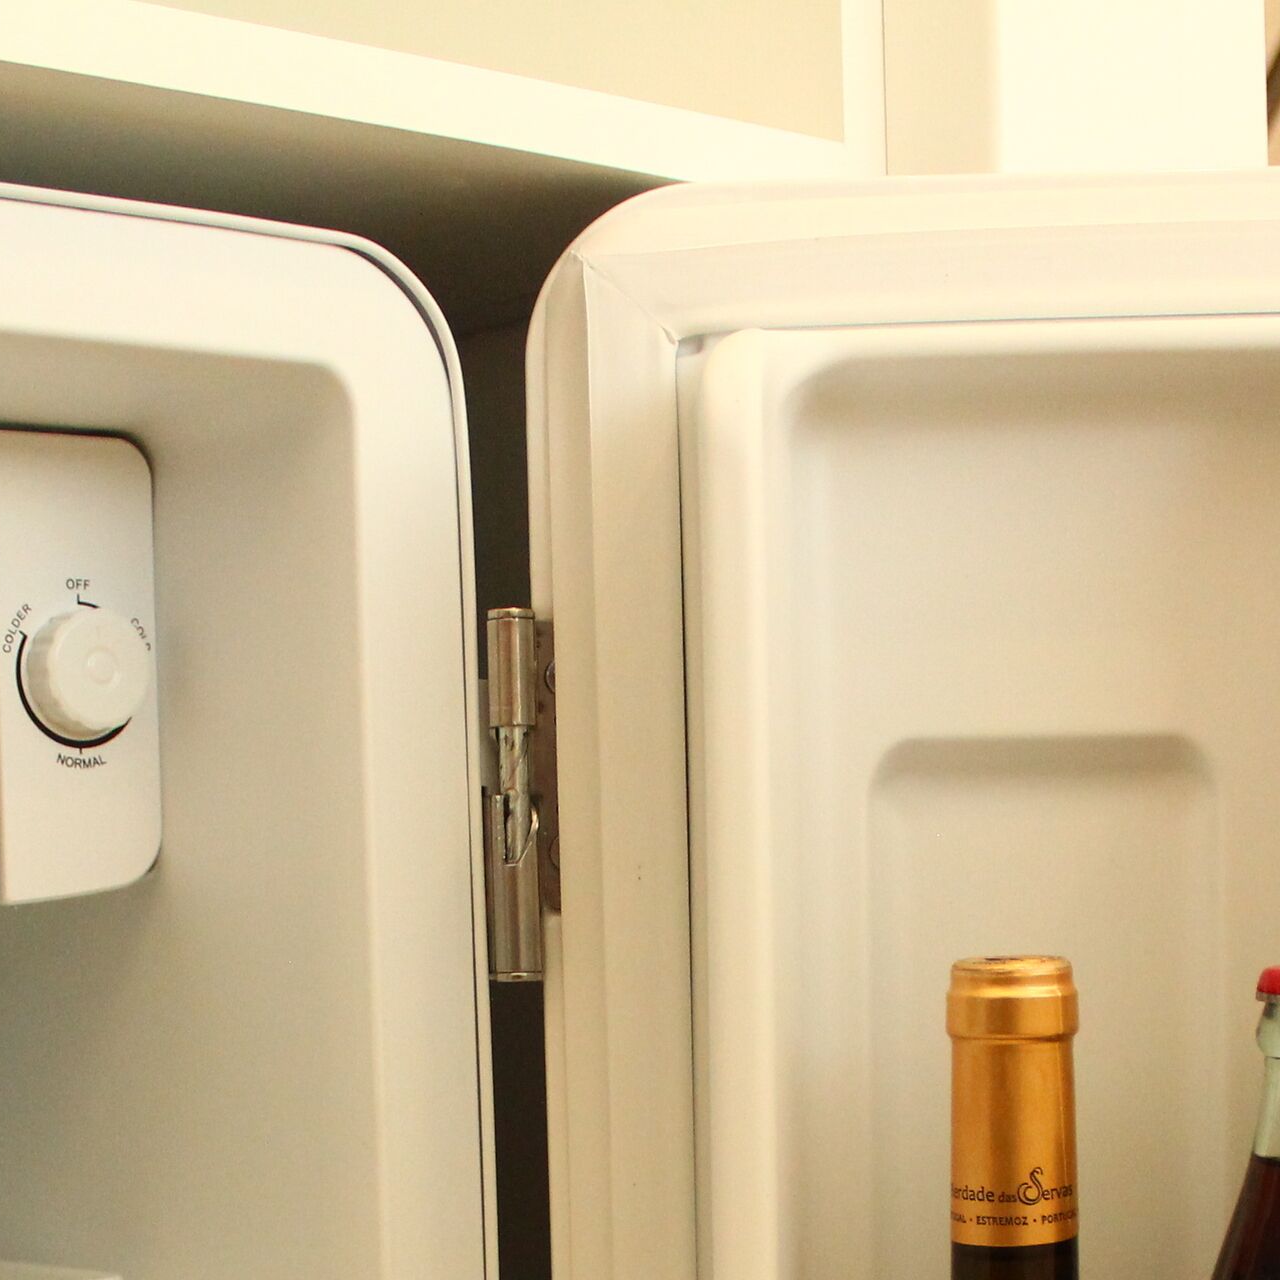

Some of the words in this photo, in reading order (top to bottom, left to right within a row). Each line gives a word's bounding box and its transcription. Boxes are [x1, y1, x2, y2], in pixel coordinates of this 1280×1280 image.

[66, 578, 90, 590] OFF
[2, 604, 32, 654] COLDER
[56, 753, 107, 769] NORMAL
[976, 1215, 1028, 1227] ESTREMOZ
